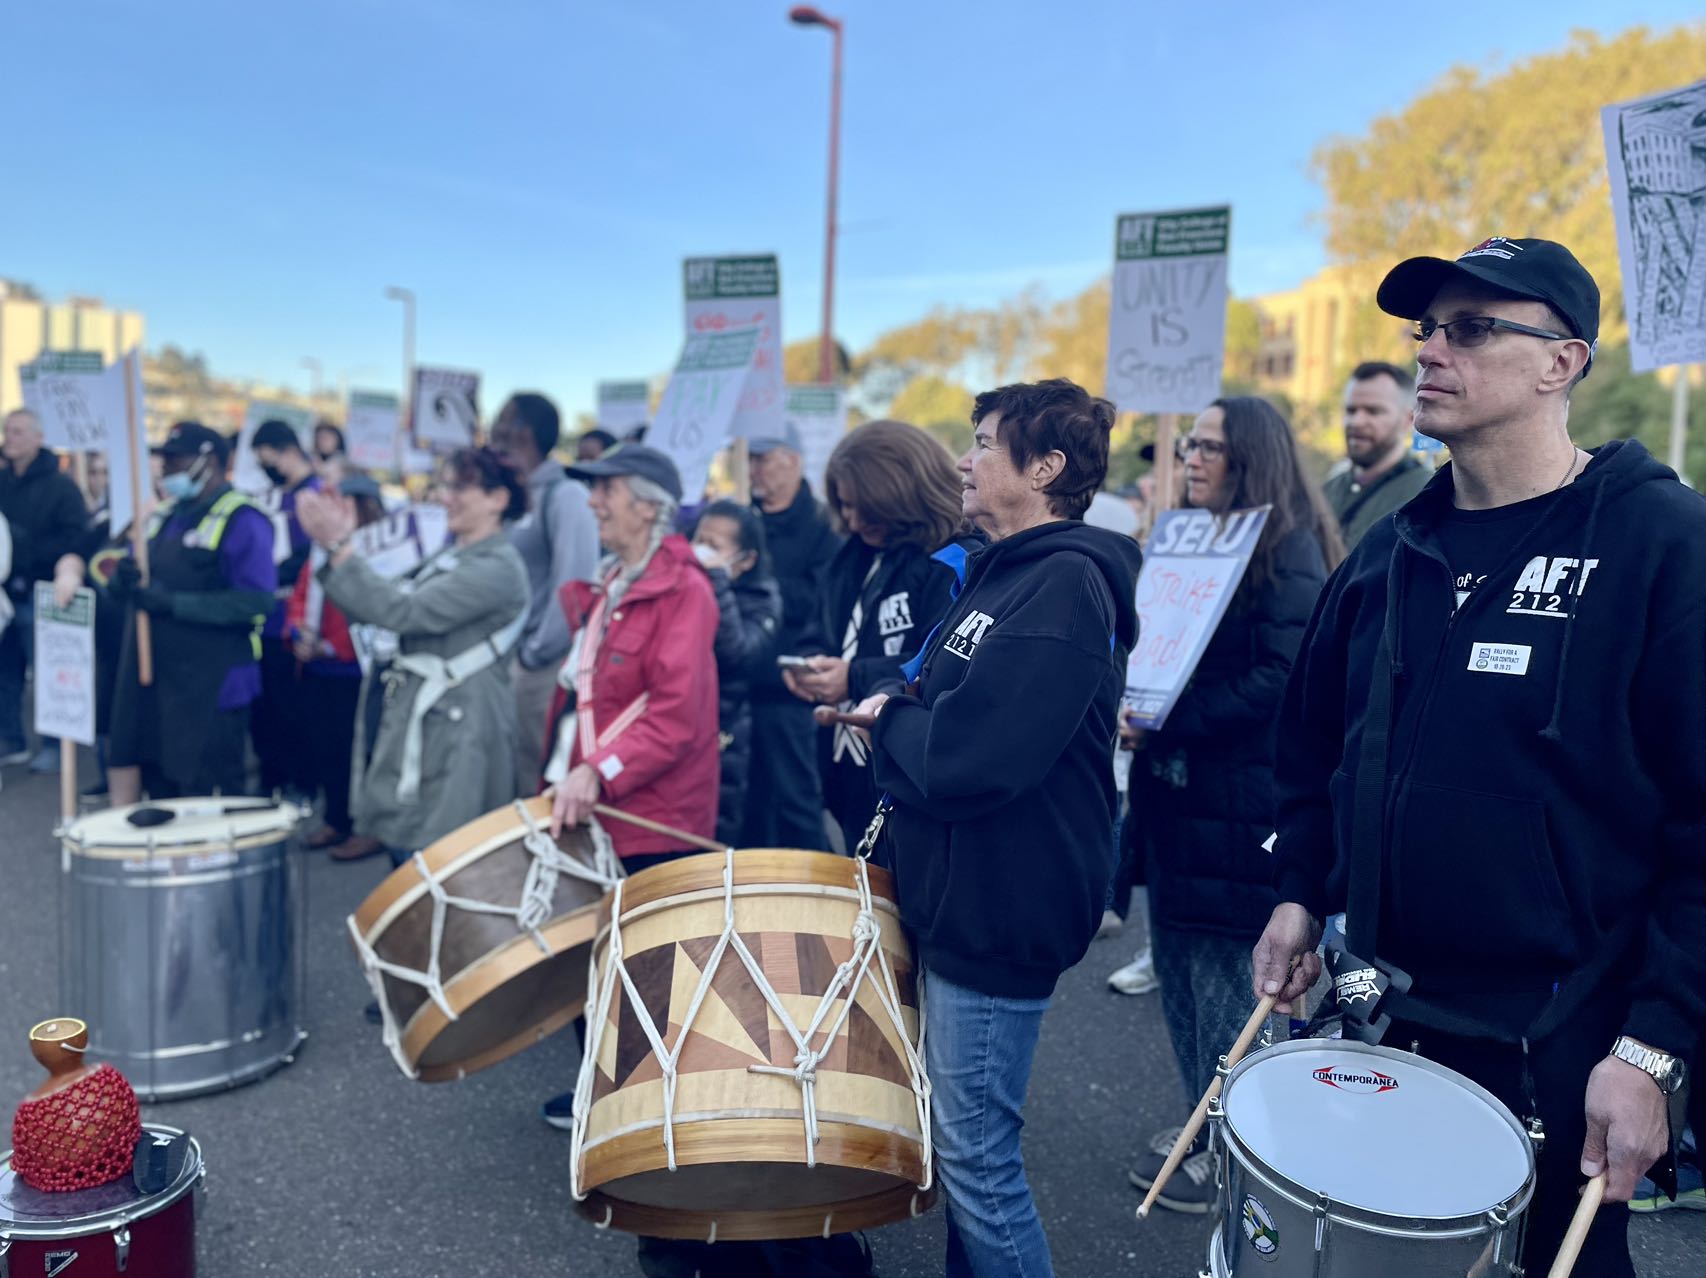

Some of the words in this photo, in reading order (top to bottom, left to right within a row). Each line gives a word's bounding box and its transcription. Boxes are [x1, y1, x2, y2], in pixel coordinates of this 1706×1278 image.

[1151, 305, 1189, 347] IS
[1152, 510, 1259, 555] SEIU
[1456, 572, 1472, 588] of
[1513, 556, 1599, 596] AFT
[945, 633, 976, 657] 2121
[953, 609, 995, 645] AFT
[1340, 983, 1371, 997] REMO
